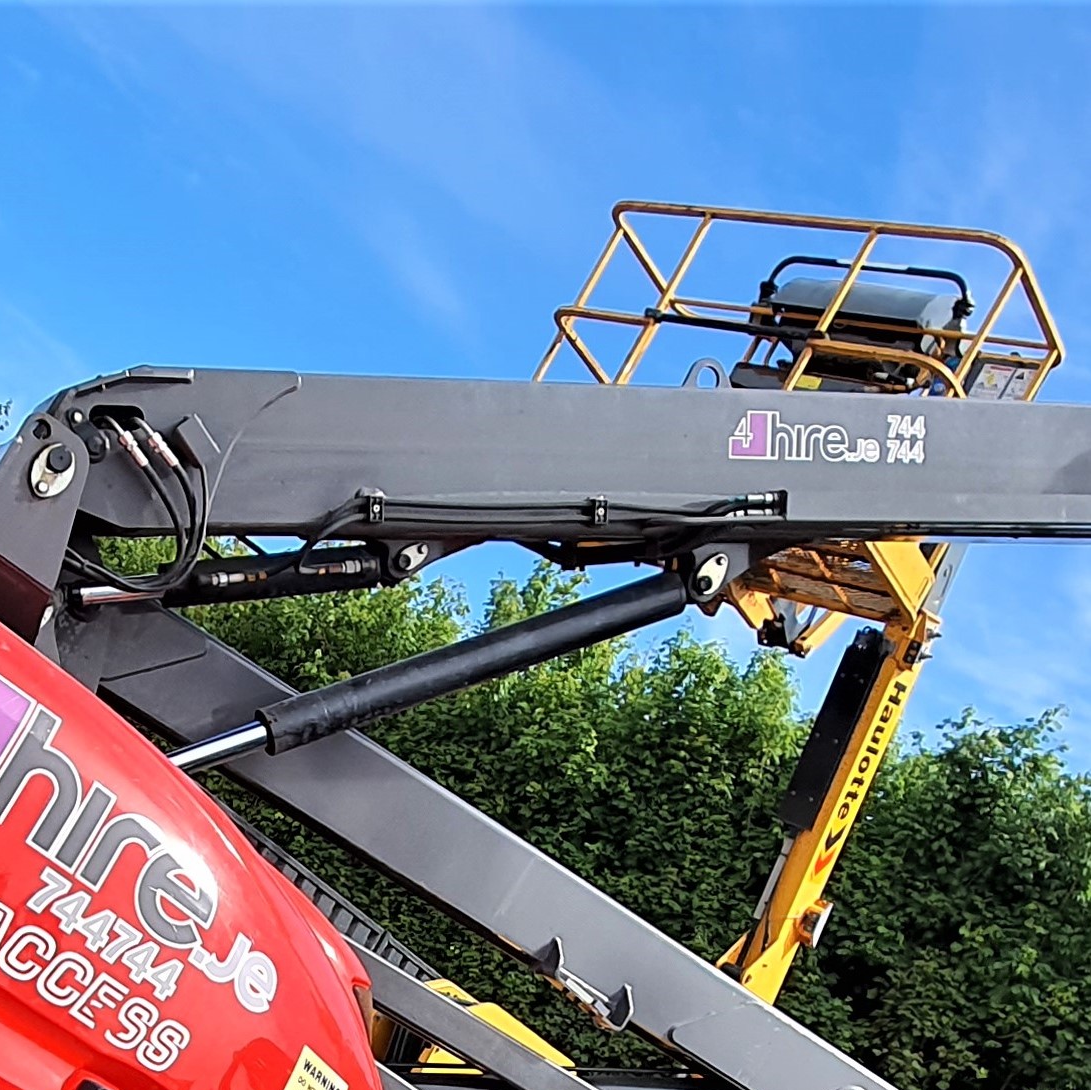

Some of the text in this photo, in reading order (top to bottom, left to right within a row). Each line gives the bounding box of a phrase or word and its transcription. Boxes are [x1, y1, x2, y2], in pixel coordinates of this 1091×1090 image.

[886, 414, 926, 439] 744
[886, 439, 925, 464] 744
[837, 681, 907, 820] Haulotte
[26, 872, 184, 1001] 744744
